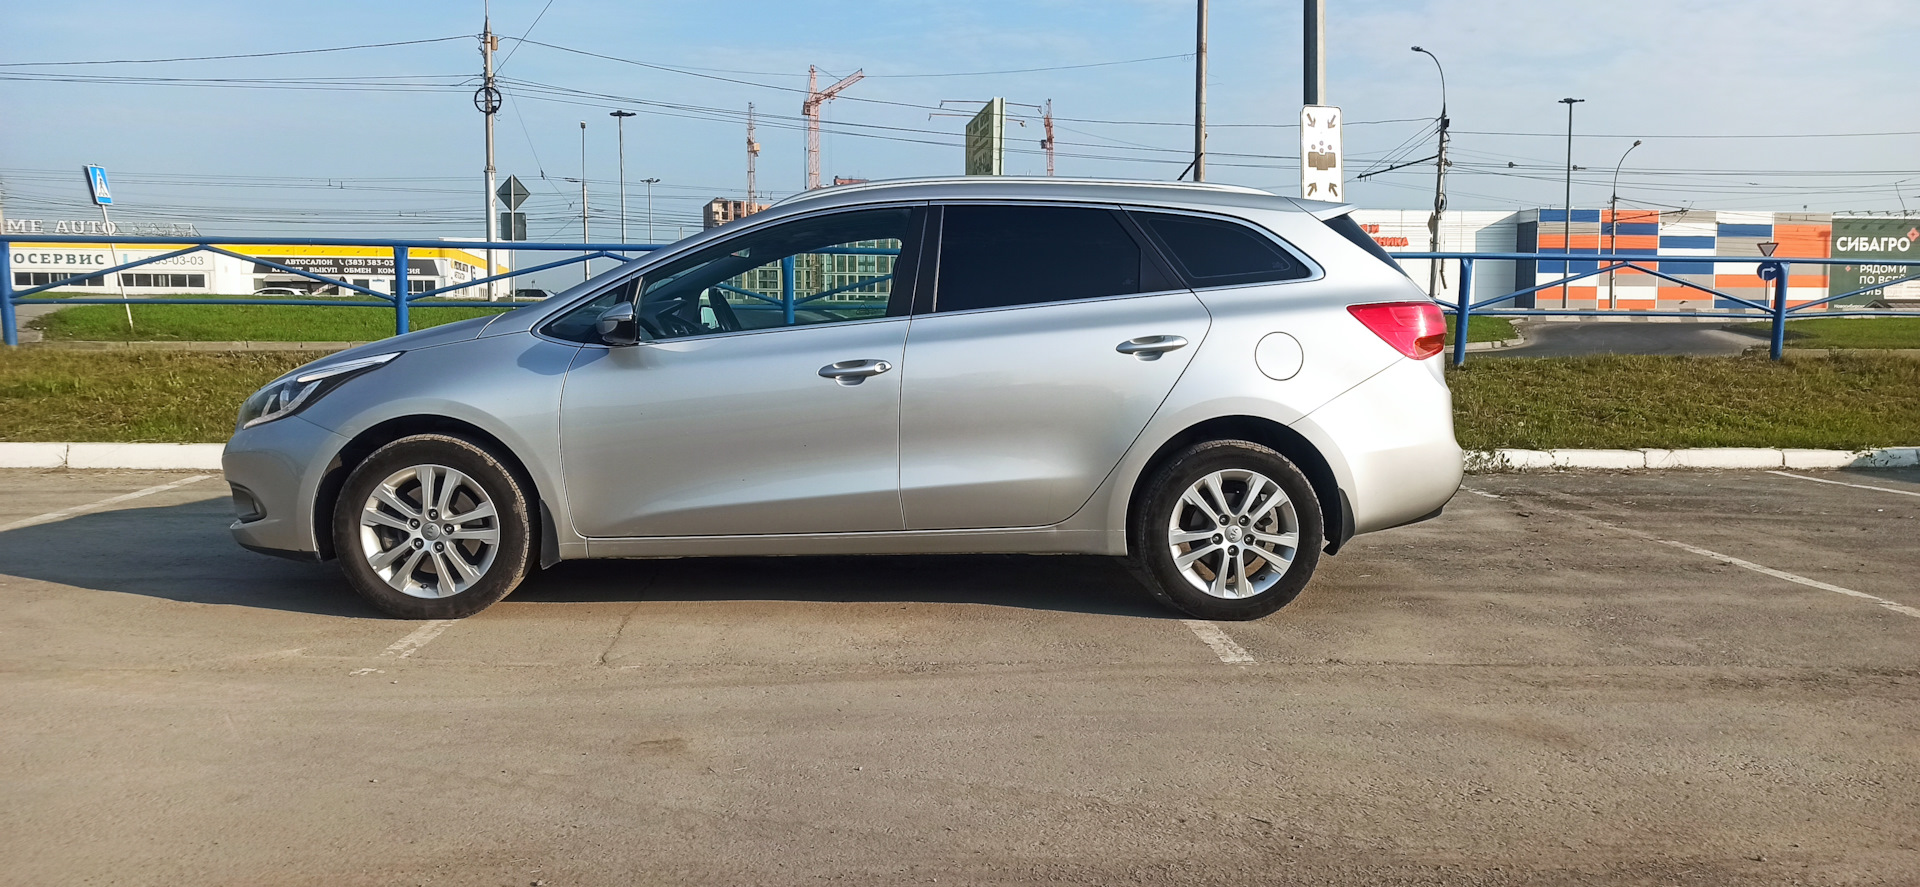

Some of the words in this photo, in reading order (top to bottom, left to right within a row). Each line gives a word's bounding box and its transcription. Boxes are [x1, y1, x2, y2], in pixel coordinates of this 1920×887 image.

[54, 220, 117, 234] AUTO
[1836, 236, 1911, 252] СИБАГРО
[284, 258, 333, 266] АВТОСАЛОН
[1859, 264, 1897, 274] РЯДОМ
[1899, 265, 1907, 274] И
[1859, 275, 1875, 284] ПО
